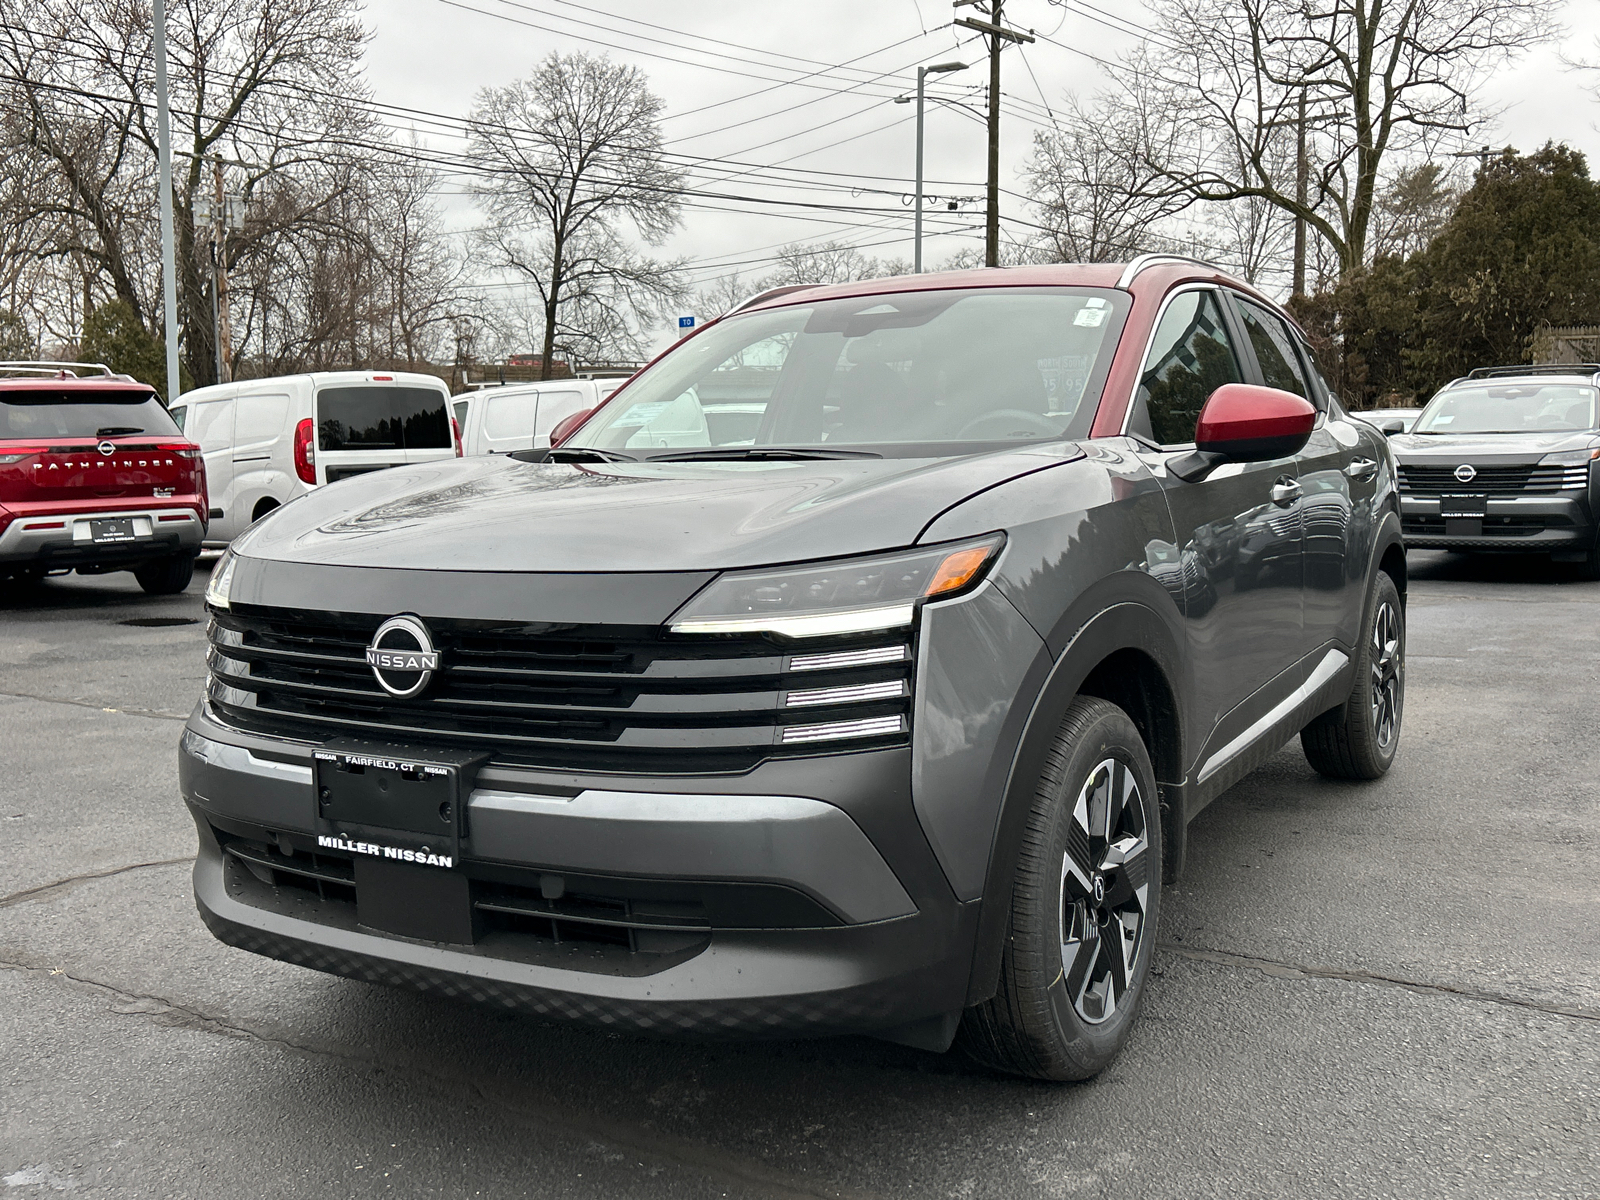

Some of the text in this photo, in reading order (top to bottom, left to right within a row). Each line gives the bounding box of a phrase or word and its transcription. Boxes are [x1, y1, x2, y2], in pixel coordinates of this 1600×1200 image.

[1066, 378, 1083, 392] 95
[32, 459, 174, 470] PATHFINDER
[366, 651, 436, 668] NISSAN
[314, 752, 337, 761] NISSAN
[345, 756, 415, 772] FAIRFIELD, CT
[424, 766, 448, 776] NISSAN
[318, 835, 452, 868] MILLER NISSAN
